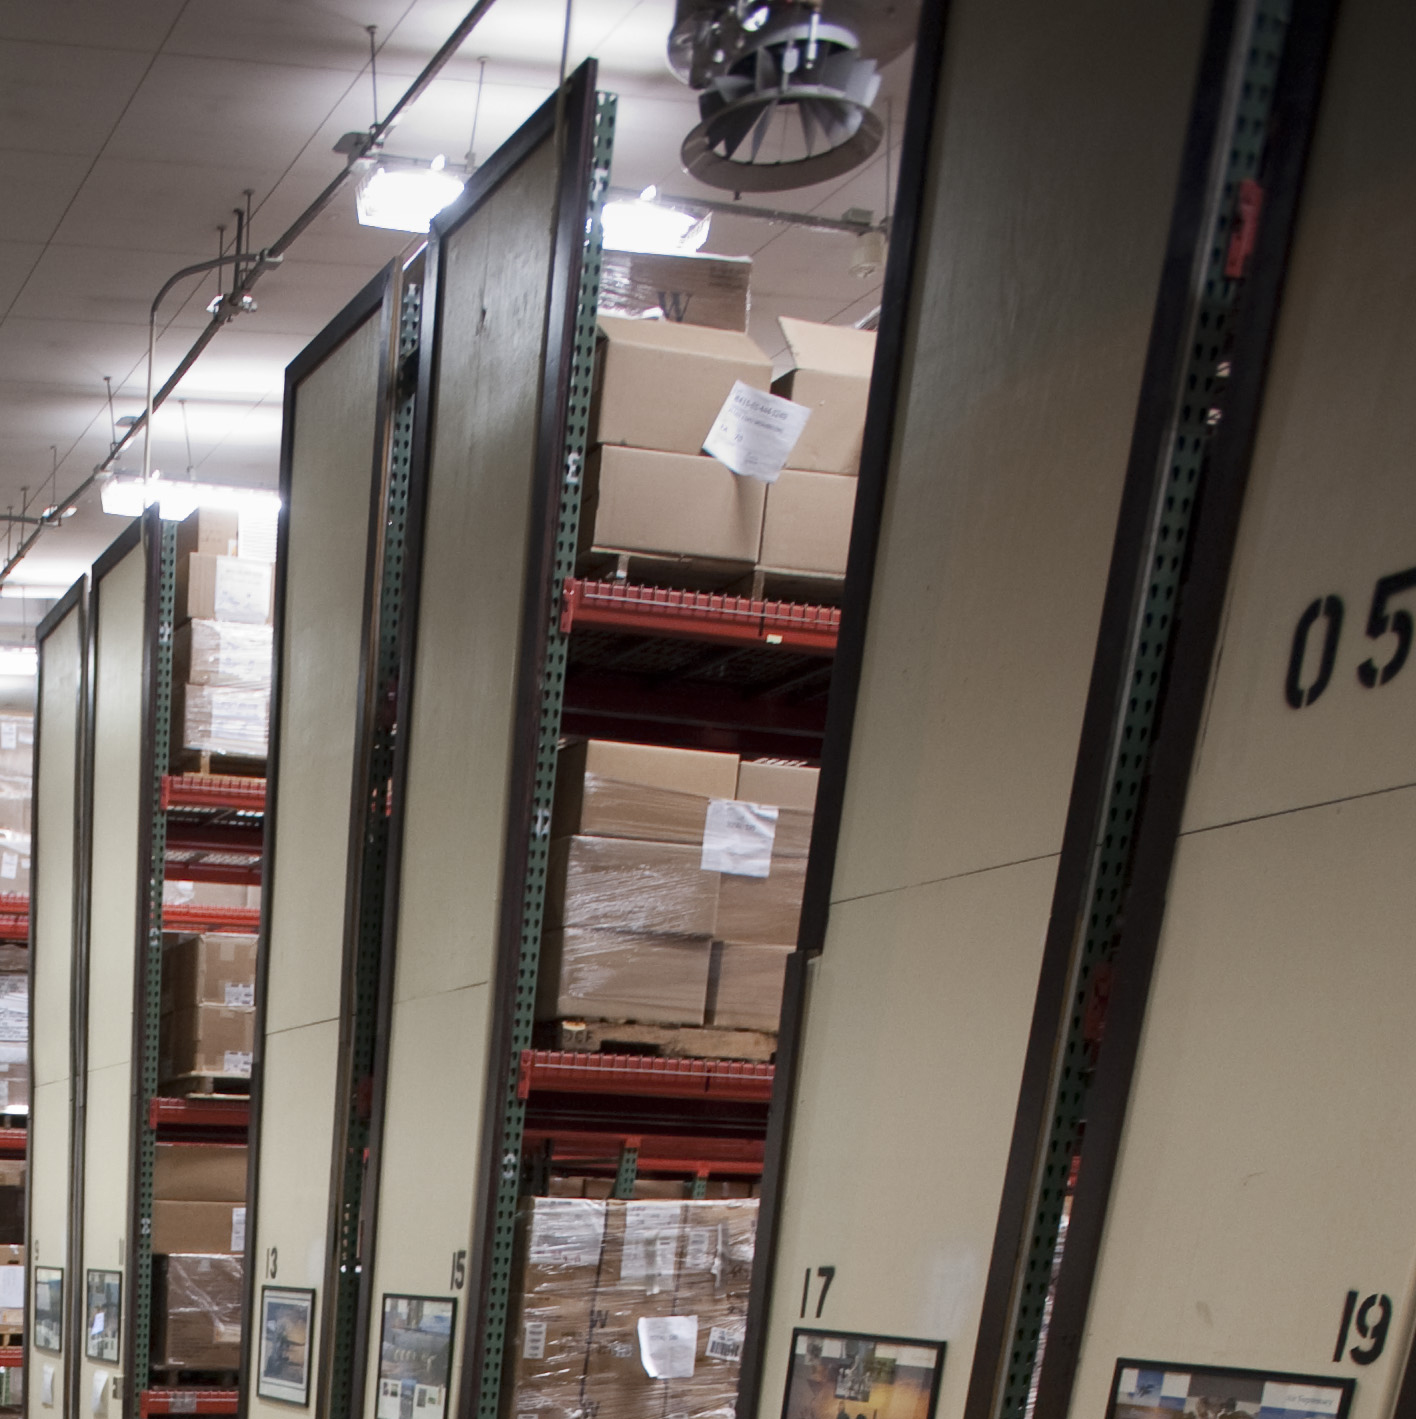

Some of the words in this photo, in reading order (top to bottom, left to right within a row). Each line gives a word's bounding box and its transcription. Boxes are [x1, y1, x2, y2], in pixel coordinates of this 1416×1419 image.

[1285, 567, 1416, 709] 05
[266, 1247, 278, 1279] 13
[450, 1250, 466, 1291] 15
[800, 1266, 835, 1319] 17
[1333, 1290, 1391, 1366] 19
